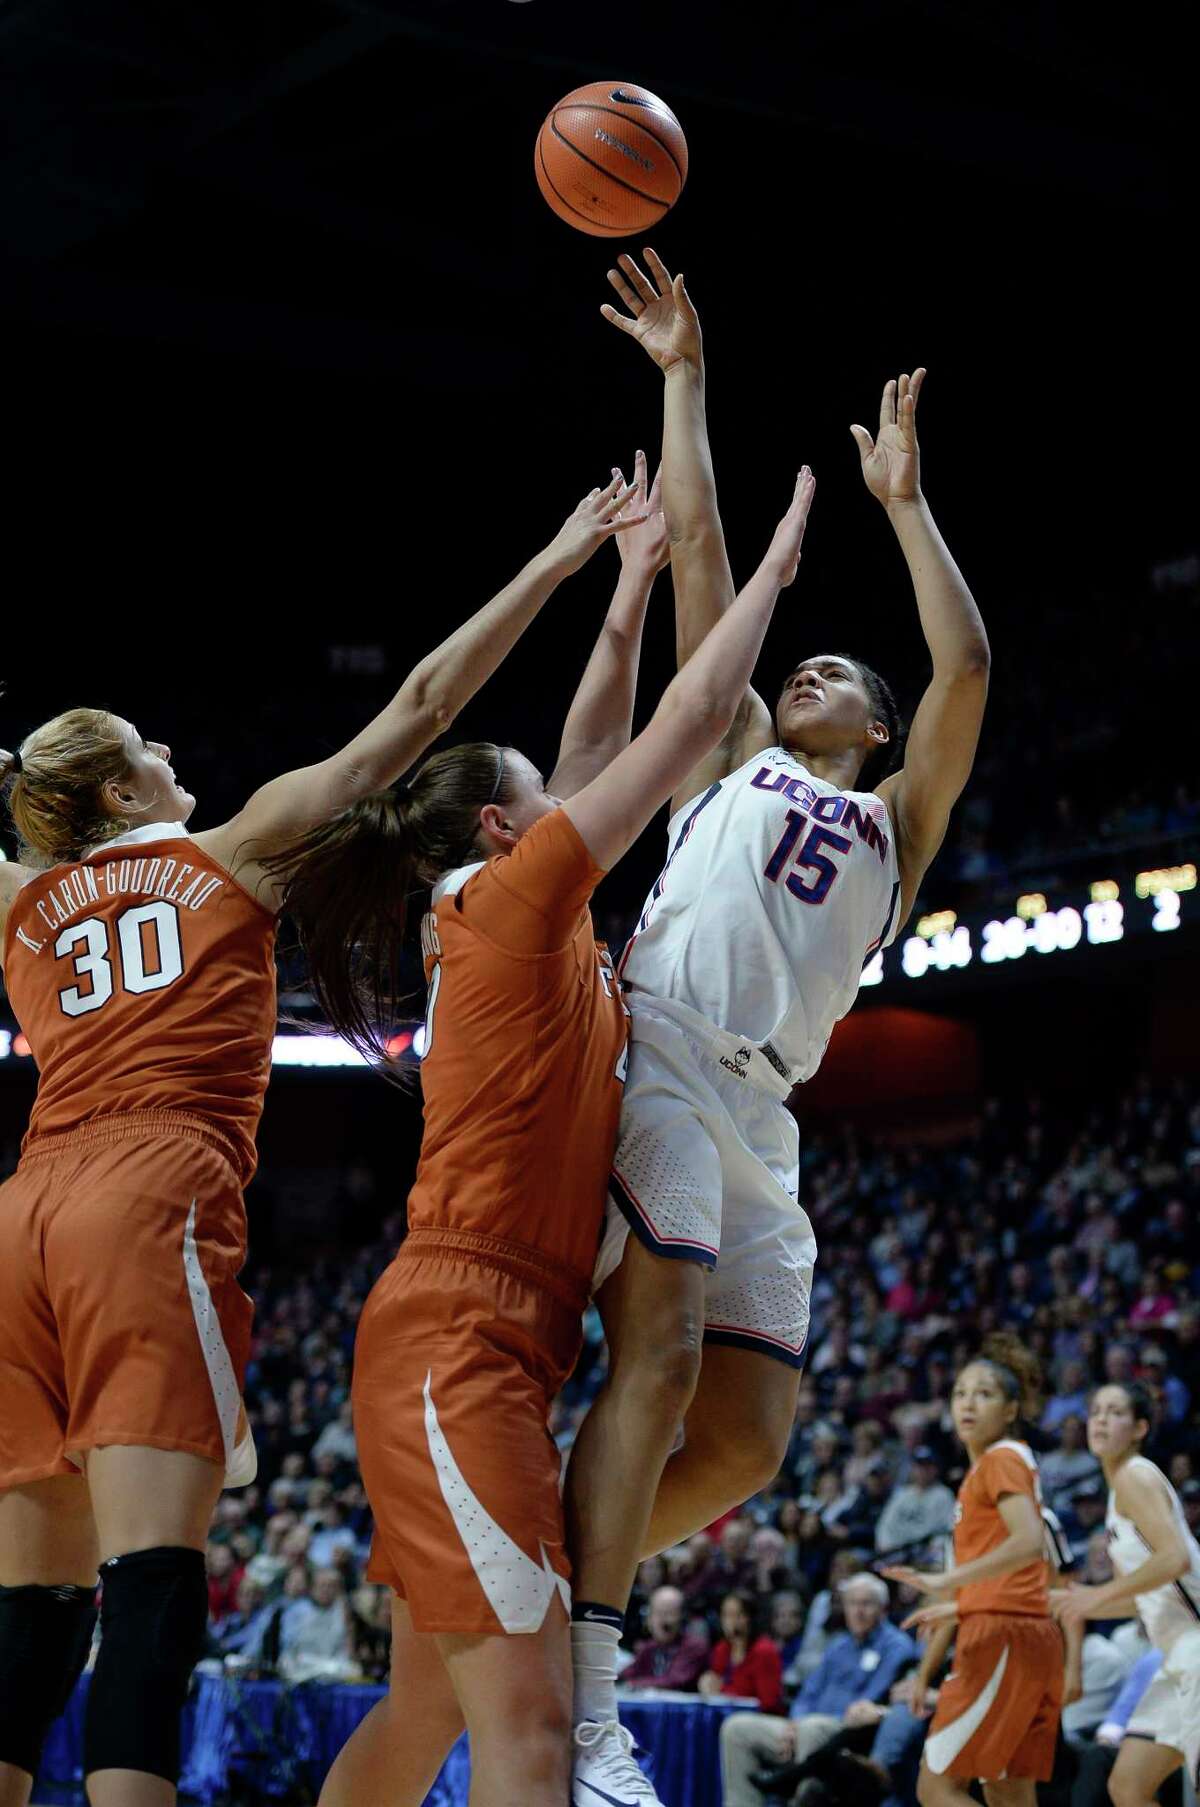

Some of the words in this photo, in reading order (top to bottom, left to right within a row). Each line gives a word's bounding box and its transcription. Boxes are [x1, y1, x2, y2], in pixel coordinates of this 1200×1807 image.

[749, 766, 890, 865] UCONN
[763, 807, 853, 905] 15
[16, 925, 48, 955] K.
[36, 857, 225, 931] CARON-GOUDREAU
[54, 900, 185, 1019] 30
[719, 1055, 748, 1080] UCONN
